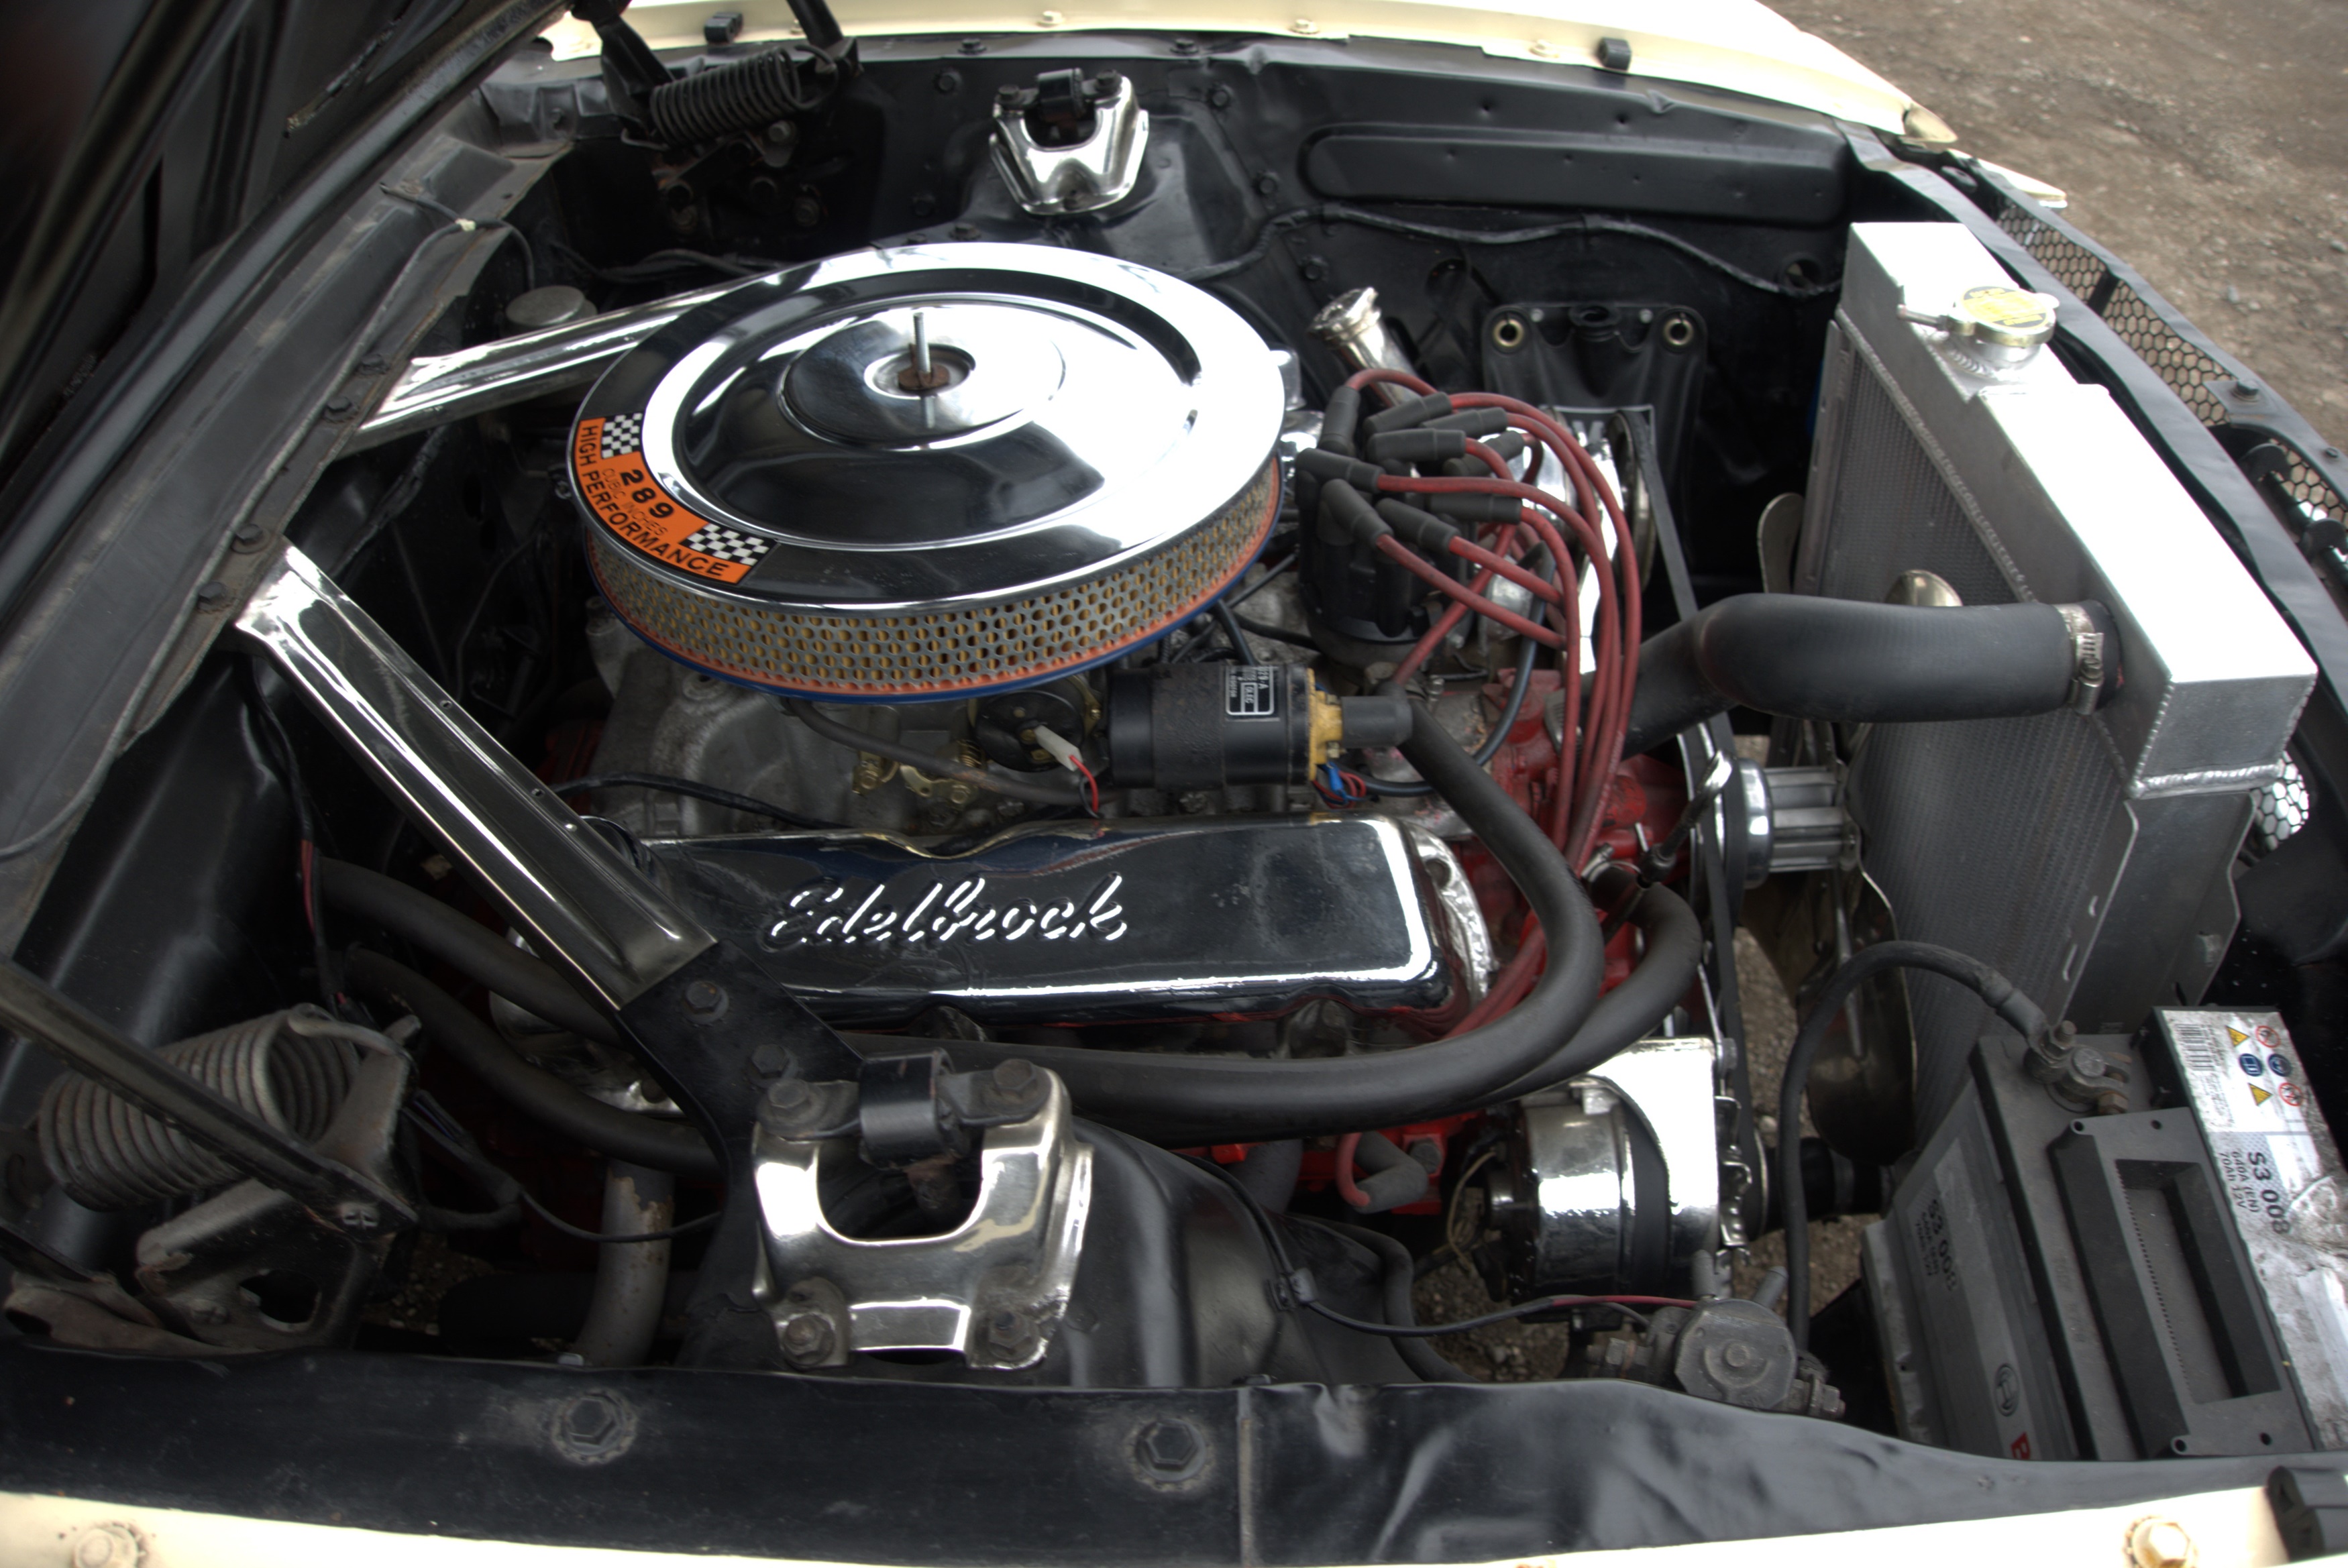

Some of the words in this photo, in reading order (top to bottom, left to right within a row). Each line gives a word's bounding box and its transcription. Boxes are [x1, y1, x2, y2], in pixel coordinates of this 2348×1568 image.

[579, 425, 598, 466] HIGH
[582, 470, 729, 577] PERFORMANCE
[602, 468, 626, 500] CUBIC
[622, 501, 668, 536] INCHES
[620, 469, 674, 518] 289
[759, 873, 1127, 951] Edelbrock
[2218, 1152, 2235, 1183] 70Ah
[2231, 1186, 2247, 1209] 12V
[2231, 1150, 2249, 1184] 640A
[2248, 1151, 2272, 1181] S3
[2262, 1190, 2291, 1234] 008
